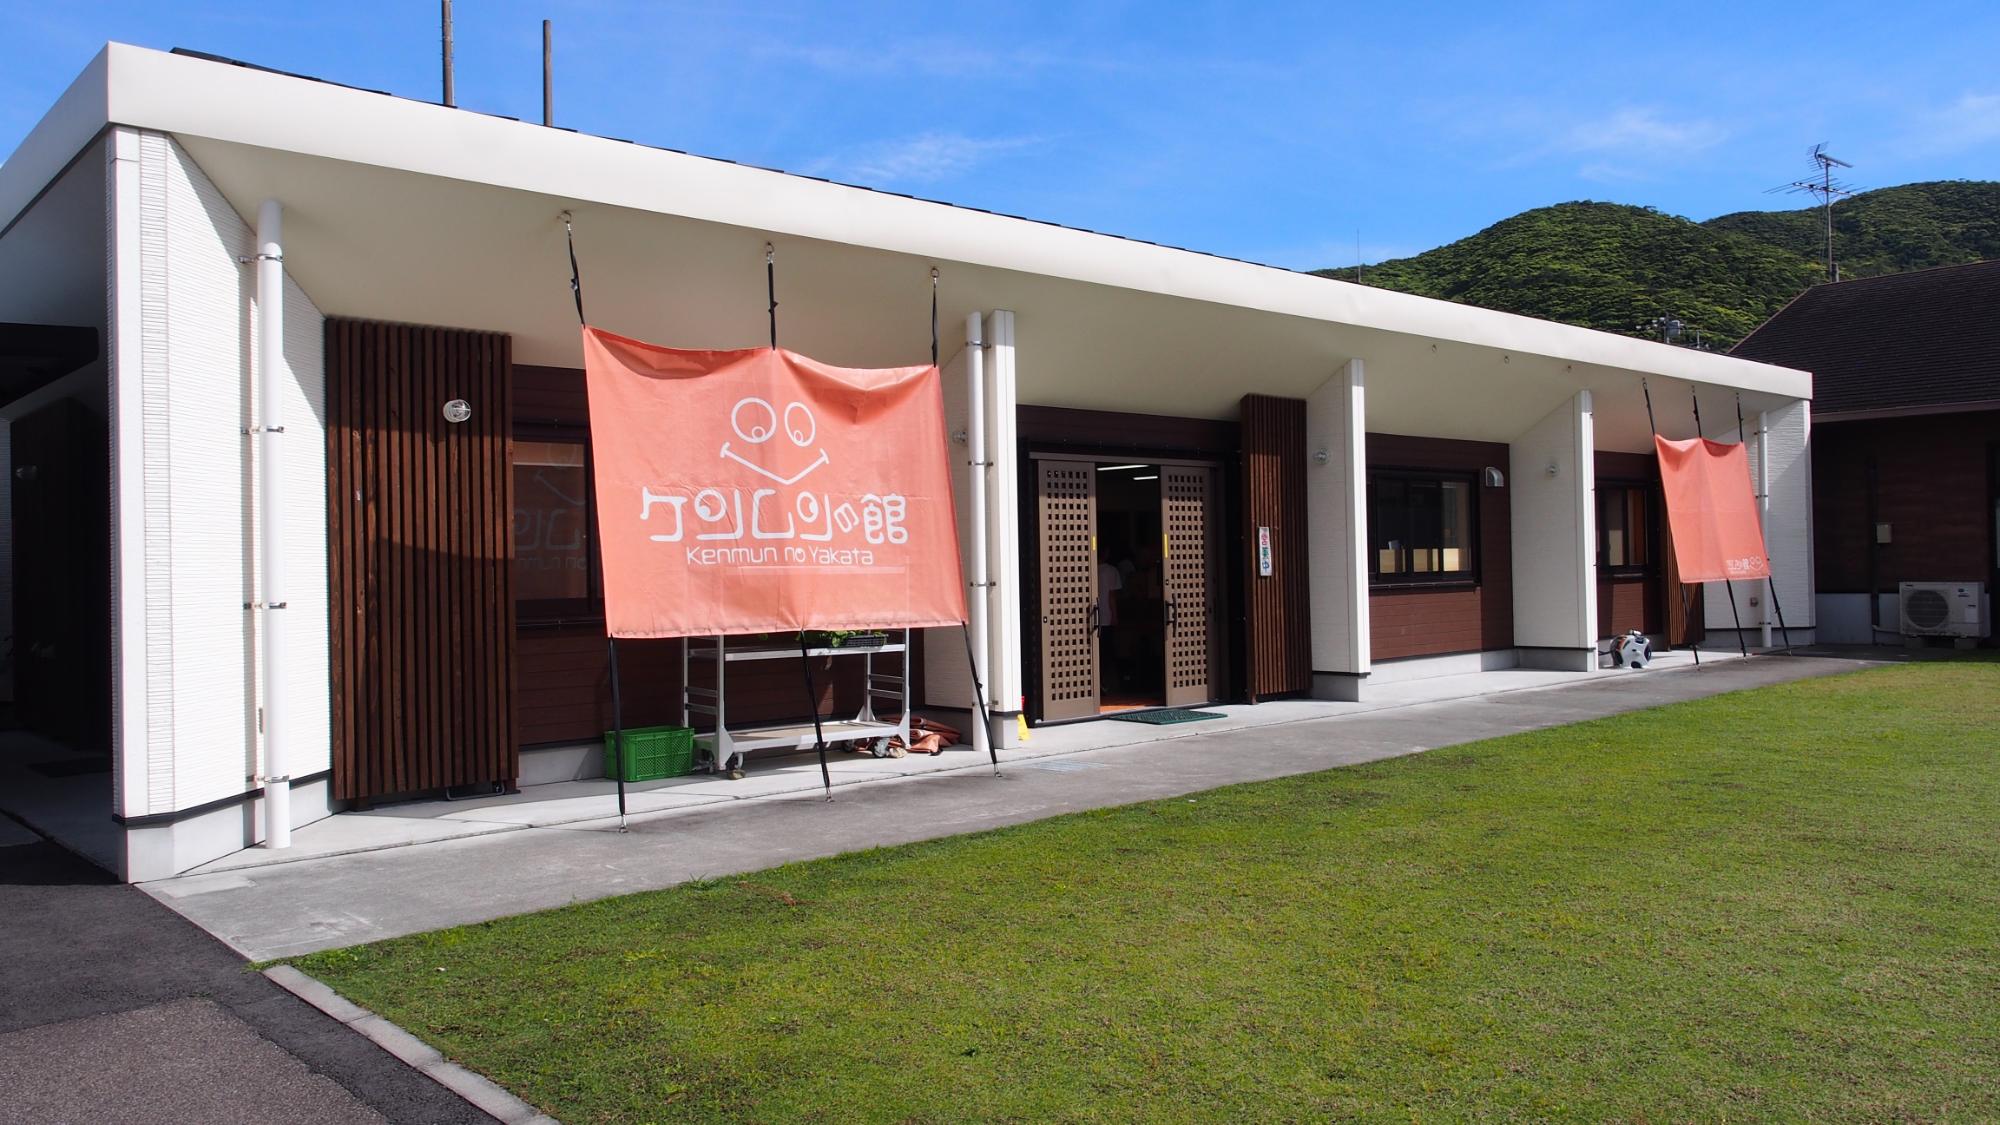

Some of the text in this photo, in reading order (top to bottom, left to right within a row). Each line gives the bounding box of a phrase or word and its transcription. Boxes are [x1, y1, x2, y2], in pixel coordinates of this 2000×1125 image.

[639, 486, 909, 544] ケンムンの館
[686, 545, 874, 566] Kenmun no Yakata
